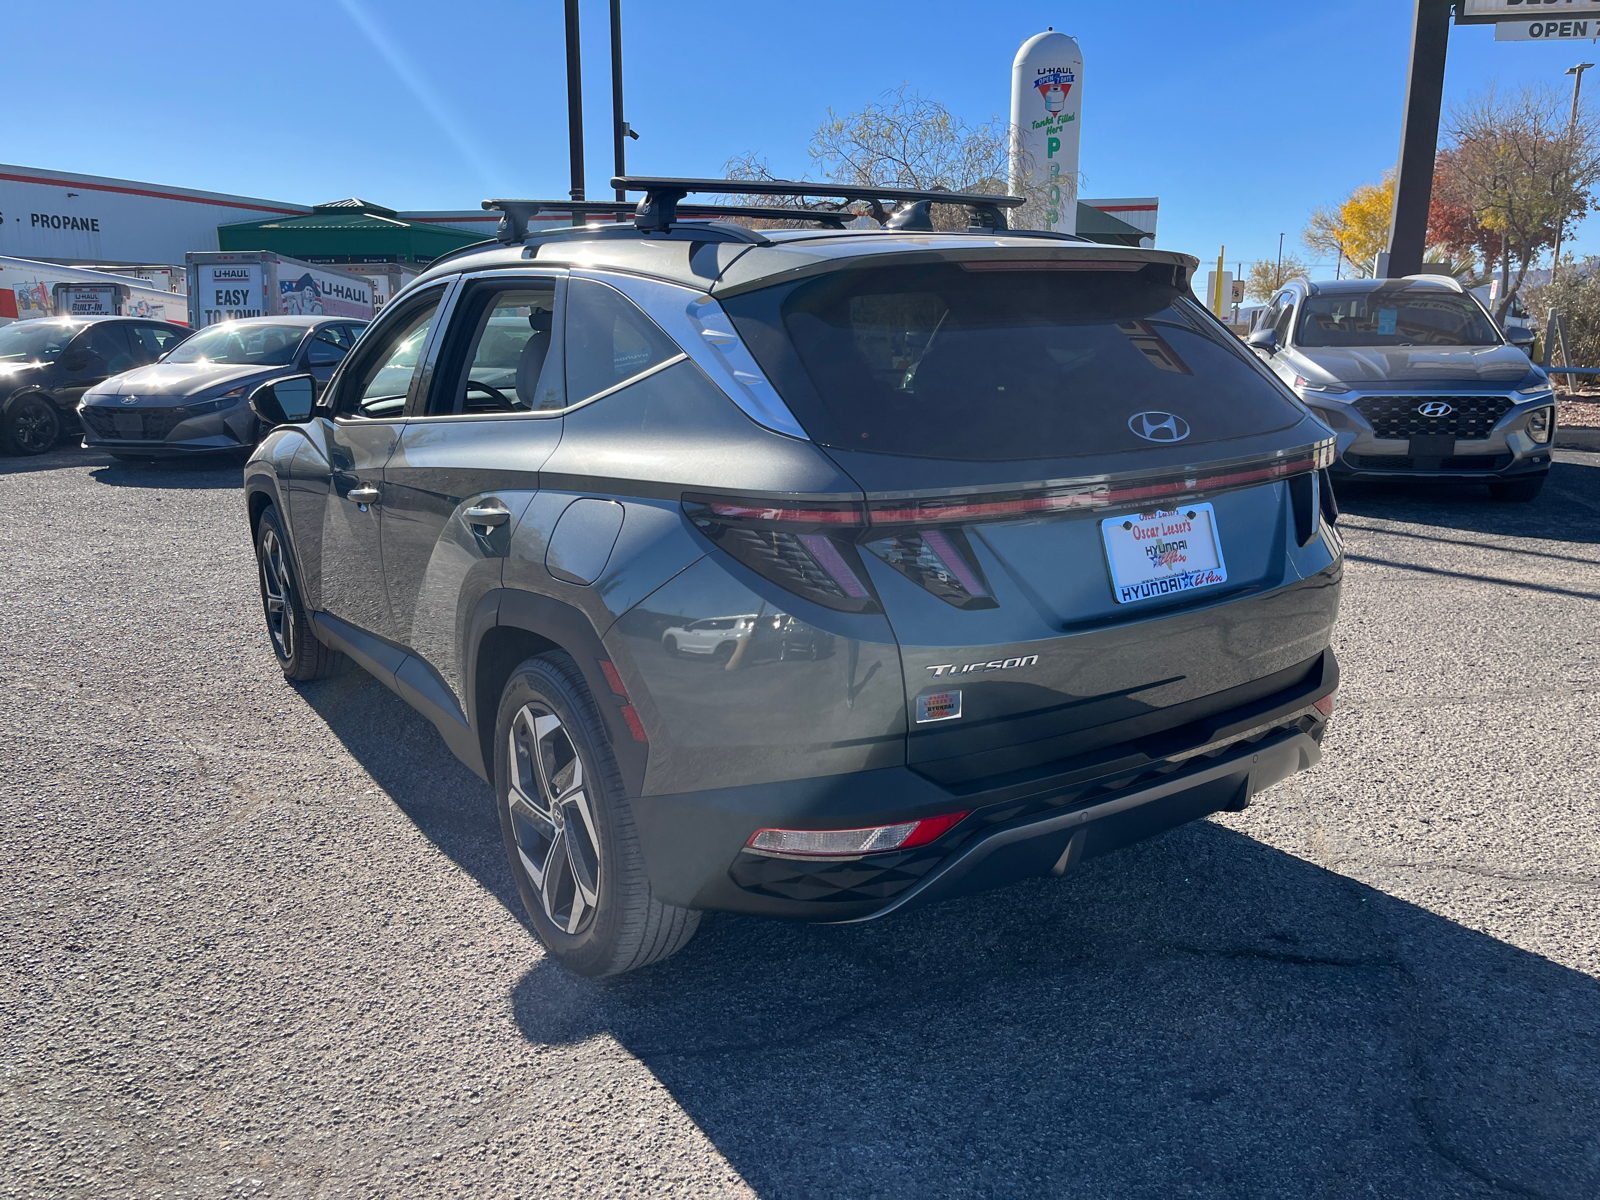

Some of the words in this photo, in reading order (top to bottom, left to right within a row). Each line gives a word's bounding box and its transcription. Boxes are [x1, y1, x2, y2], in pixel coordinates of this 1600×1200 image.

[1528, 22, 1588, 38] OPEN
[1037, 67, 1073, 75] U-HAUL
[1038, 75, 1054, 85] OPEN
[1061, 75, 1072, 83] DAYS
[1031, 116, 1054, 130] Tanks
[1057, 112, 1076, 125] Filled
[1046, 125, 1063, 136] Here
[31, 213, 100, 232] PROPANE
[214, 270, 249, 278] U-HAUL
[215, 290, 250, 306] EASY
[321, 281, 368, 304] U-HAUL
[72, 303, 103, 311] BUILT-IN
[205, 310, 222, 326] TO
[1139, 513, 1157, 521] Oscar
[1132, 525, 1159, 540] Oscar
[1161, 519, 1192, 537] Leeser's
[1145, 540, 1187, 556] HYUNDAI
[1195, 572, 1205, 586] El
[1205, 570, 1223, 585] Paso
[1121, 577, 1182, 601] HYUNDAI
